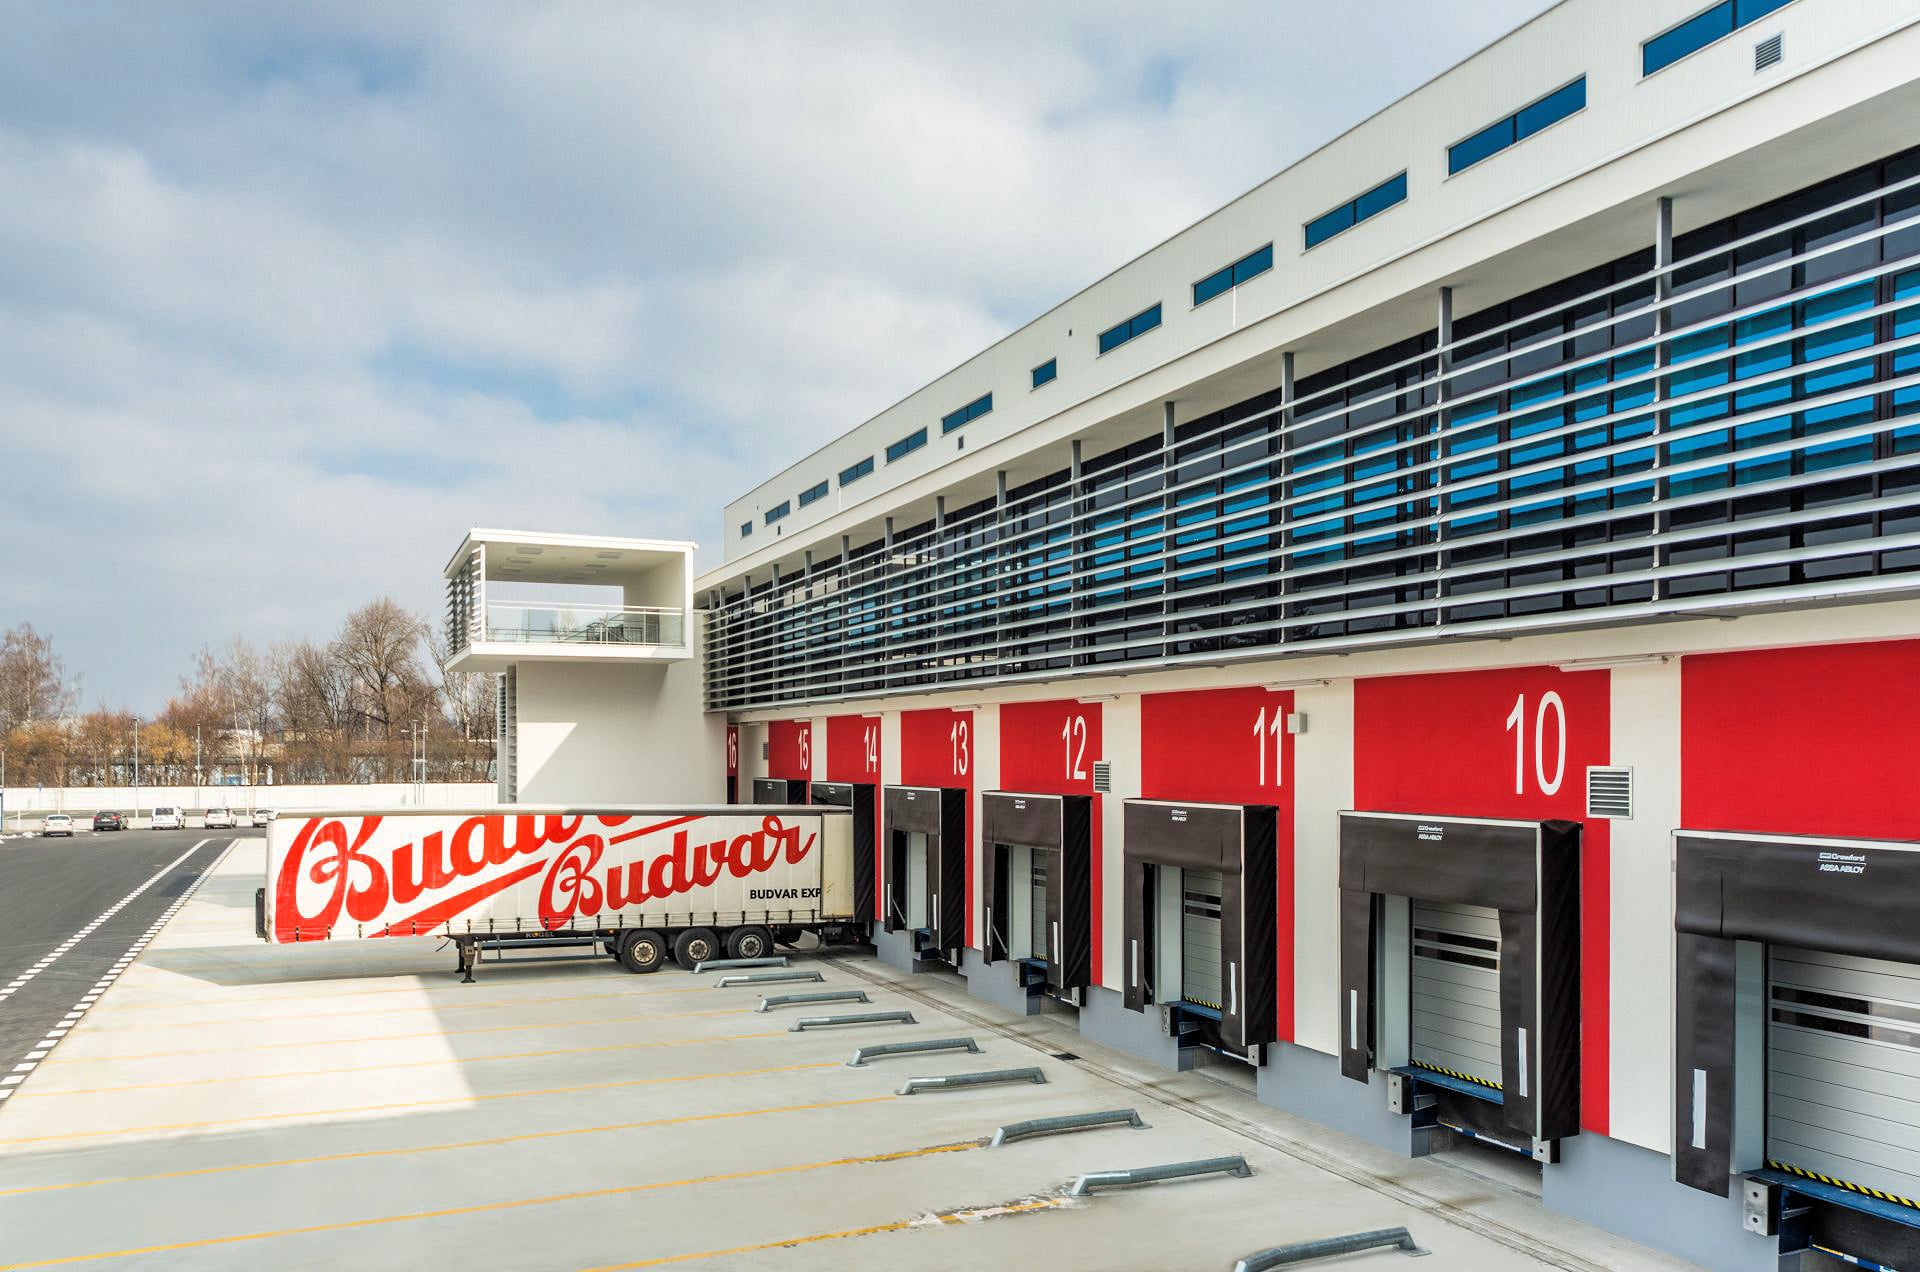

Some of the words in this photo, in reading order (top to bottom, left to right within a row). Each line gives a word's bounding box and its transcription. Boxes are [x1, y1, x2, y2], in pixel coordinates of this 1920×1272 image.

[728, 732, 737, 769] 16
[798, 729, 809, 771] 15
[864, 726, 877, 773] 14
[950, 720, 968, 776] 13
[1062, 715, 1087, 780] 12
[1253, 705, 1282, 787] 11
[1506, 691, 1566, 796] 10
[538, 815, 817, 931] Budvar
[1819, 863, 1840, 872] ASSA
[1840, 865, 1864, 873] ABLOY
[750, 888, 798, 900] BUDVAR
